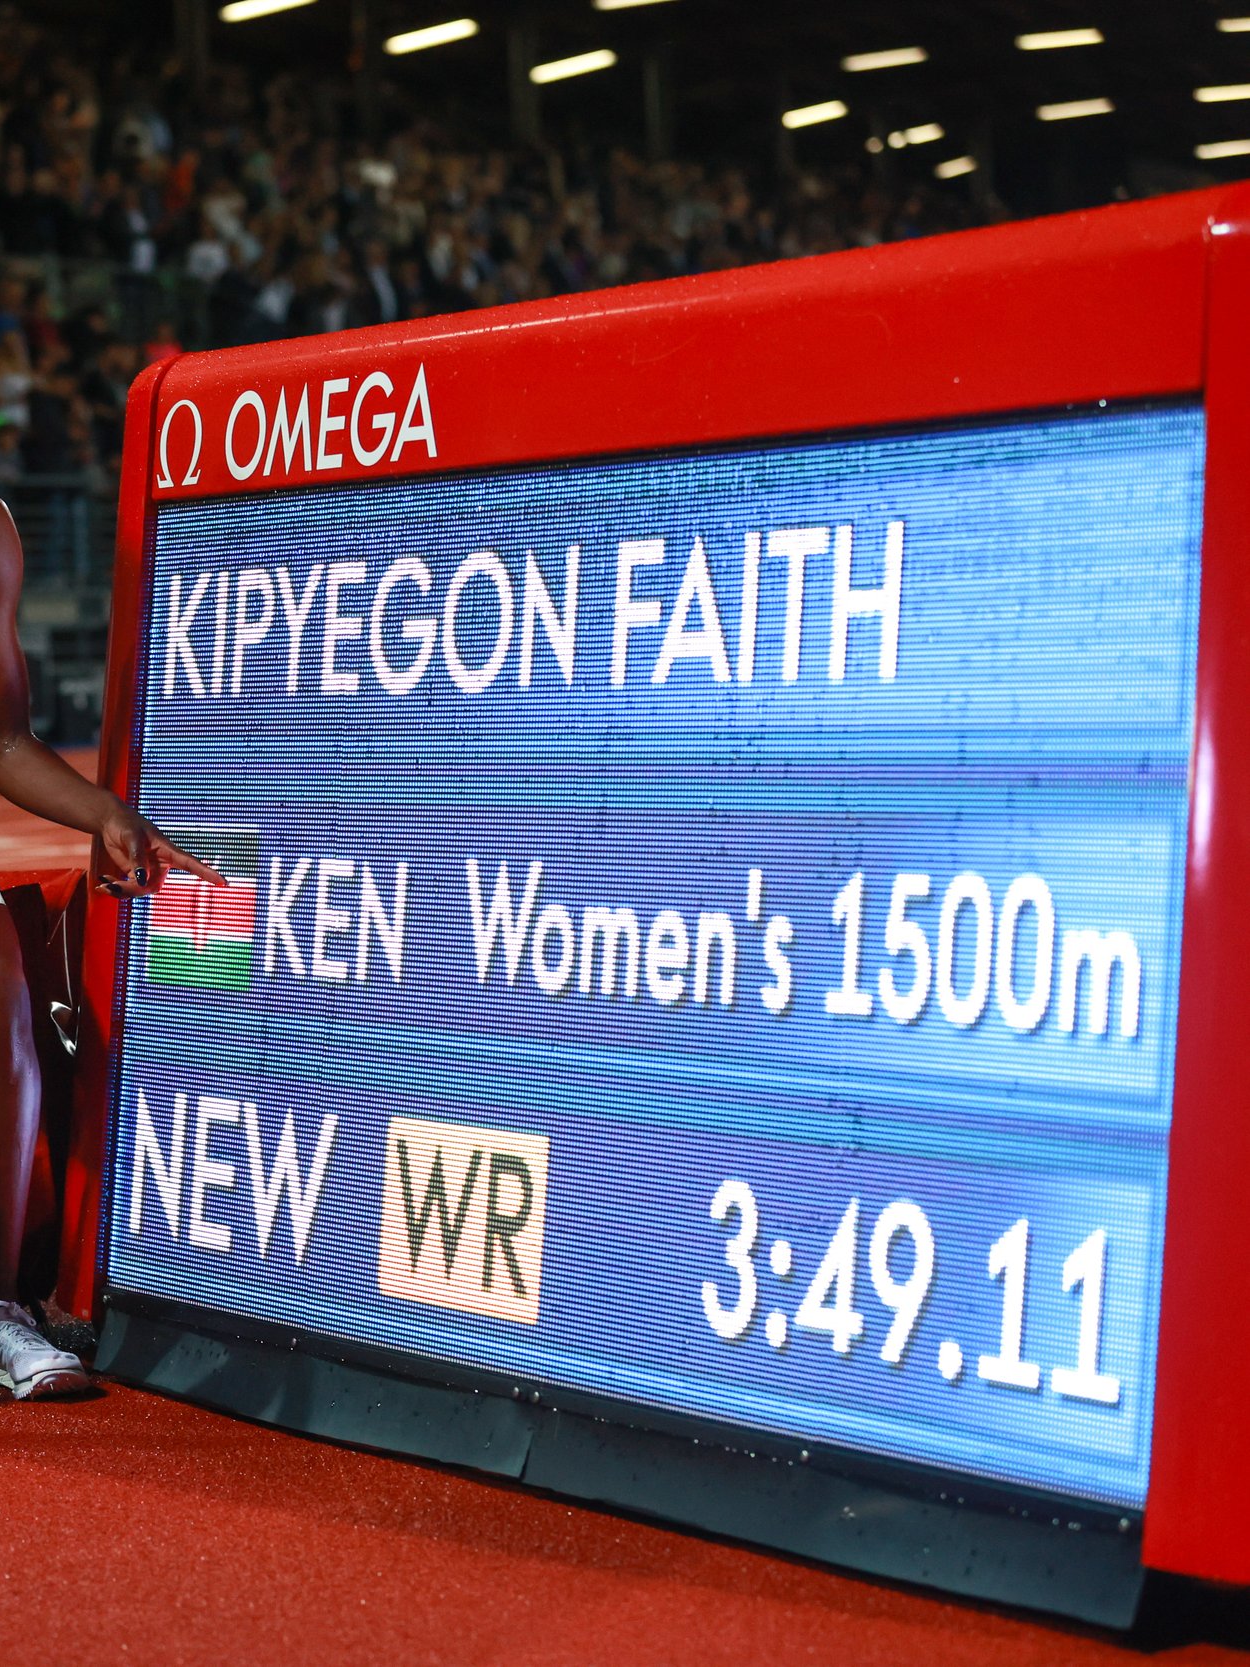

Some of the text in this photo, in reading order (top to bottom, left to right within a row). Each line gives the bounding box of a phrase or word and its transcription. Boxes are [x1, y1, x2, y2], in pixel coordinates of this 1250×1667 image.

[225, 362, 438, 481] OMEGA
[162, 520, 904, 699] KIPYEGON FAITH
[264, 856, 1141, 1037] KEN Women's 1500m
[130, 1087, 1121, 1403] NEW WR 3:49.11
